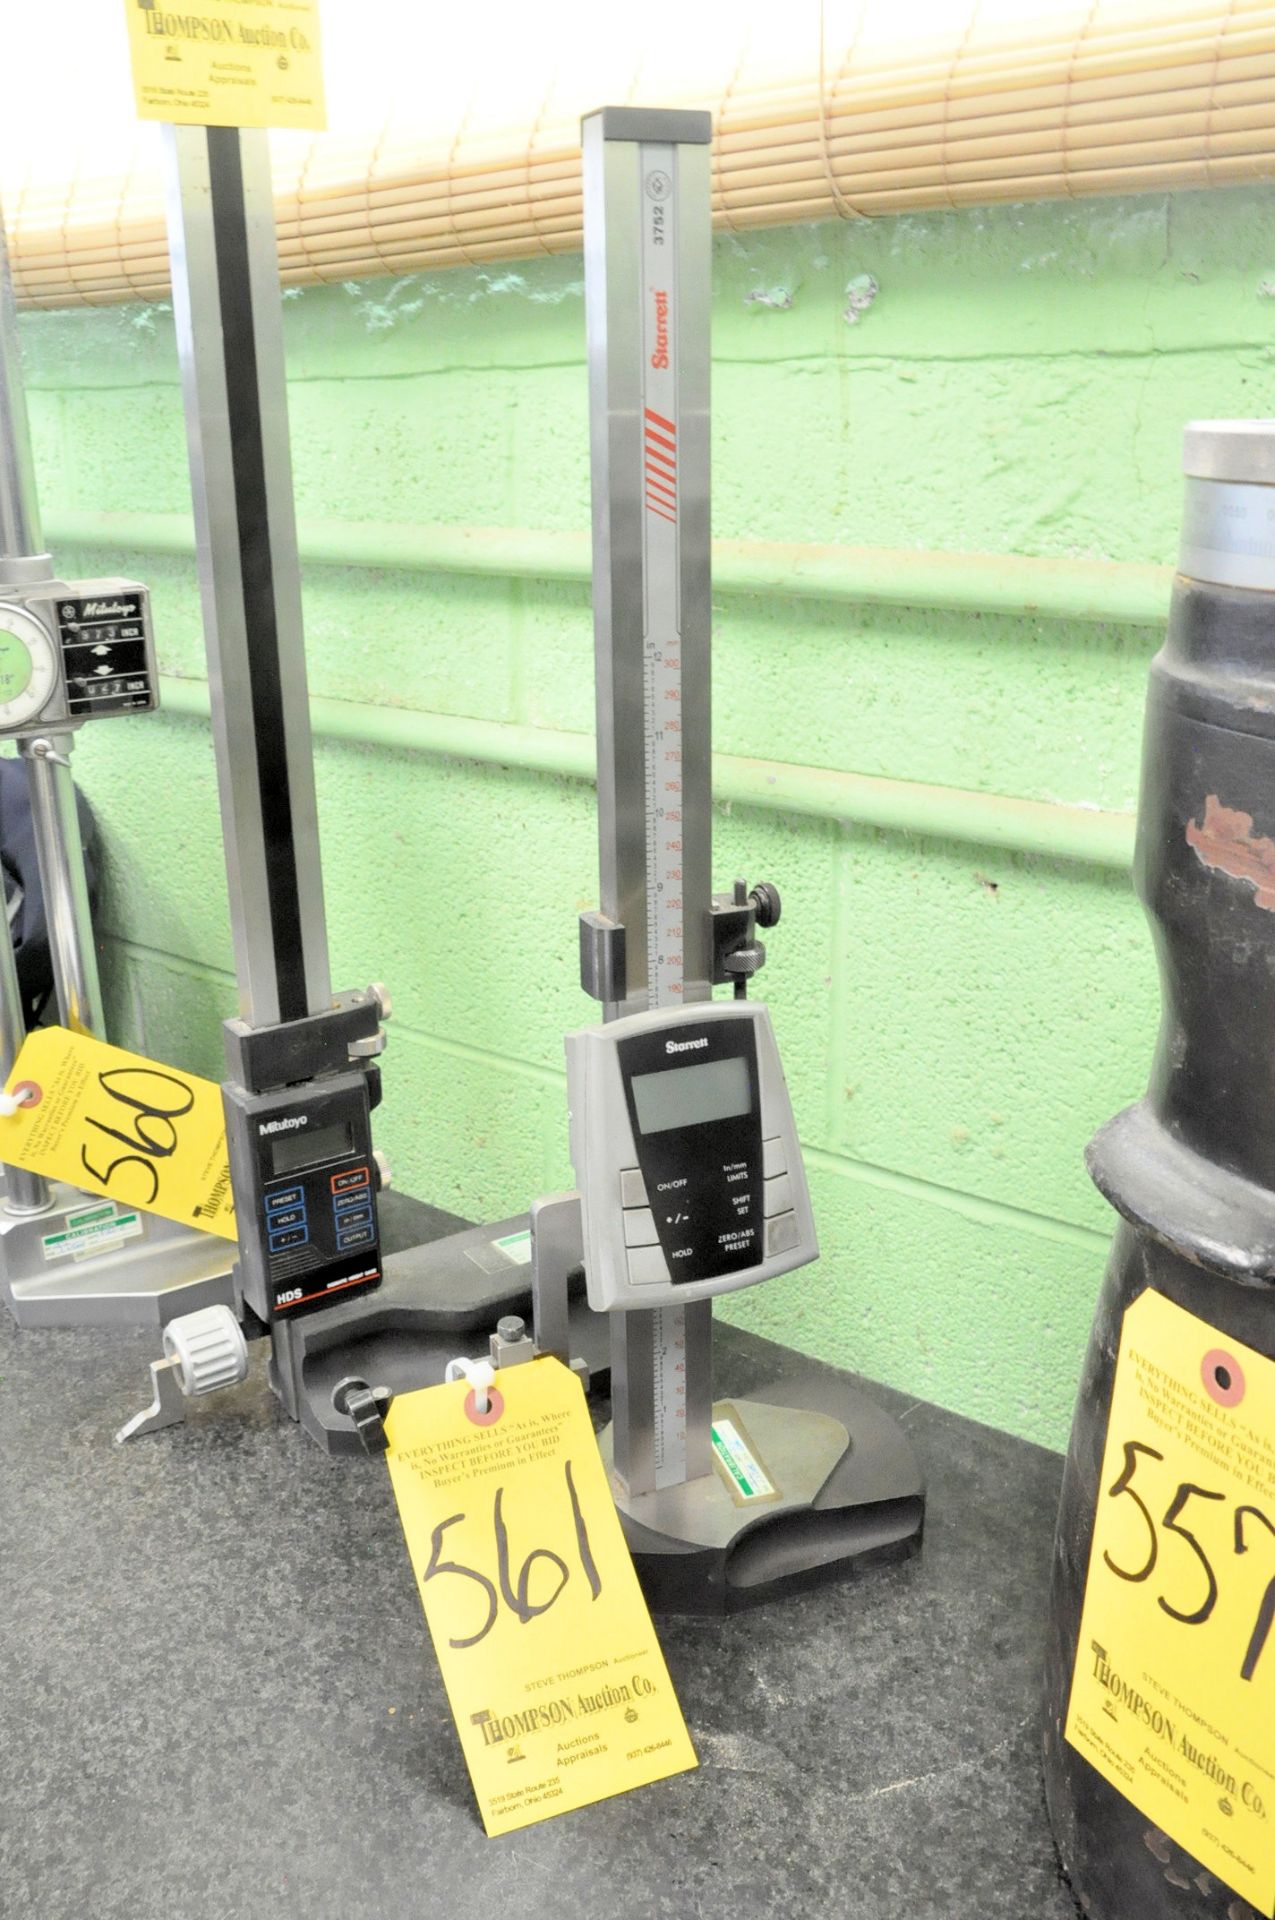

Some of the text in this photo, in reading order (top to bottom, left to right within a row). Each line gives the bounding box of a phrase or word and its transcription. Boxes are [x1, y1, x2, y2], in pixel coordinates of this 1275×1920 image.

[137, 0, 233, 42] THOMPSON
[239, 24, 287, 48] Auction
[212, 61, 251, 72] Auctions
[653, 206, 664, 245] 3752
[651, 291, 669, 370] Starrett
[83, 602, 136, 617] Mitutoyo
[665, 1037, 709, 1054] Starrett
[82, 1068, 194, 1204] 560
[259, 1115, 307, 1136] Mitutoyo
[657, 1179, 688, 1191] ON/OFF
[727, 1172, 748, 1183] LIMITS
[272, 1194, 297, 1206] PRESET
[732, 1195, 750, 1205] SHIFT
[737, 1206, 749, 1215] SET
[277, 1214, 296, 1224] HOLD
[344, 1231, 368, 1244] OUTPUT
[718, 1229, 755, 1243] ZERO/ABS
[725, 1240, 750, 1251] PRESET
[672, 1248, 693, 1259] HOLD
[277, 1288, 303, 1304] HDS
[1128, 1349, 1198, 1404] EVERYTHING
[1200, 1400, 1236, 1431] SELLS
[1147, 1376, 1159, 1393] No
[1163, 1386, 1214, 1431] Warranties
[1216, 1428, 1227, 1439] or
[398, 1435, 471, 1462] EVERYTHING
[474, 1426, 507, 1443] SELLS
[542, 1410, 572, 1425] Where
[1139, 1386, 1265, 1478] INSPECT BEFORE YOU
[420, 1434, 560, 1480] INSPECT BEFORE YOU BID
[424, 1455, 437, 1467] No
[439, 1441, 492, 1464] Warranties
[494, 1440, 504, 1449] or
[1185, 1433, 1229, 1472] Premium
[1233, 1466, 1243, 1479] in
[434, 1448, 556, 1488] Buyer's Premium in Effect
[423, 1460, 601, 1648] 561
[525, 1678, 555, 1693] STEVE
[557, 1659, 609, 1682] THOMPSON
[470, 1698, 574, 1746] THOMPSON
[578, 1684, 631, 1716] Auction
[1091, 1639, 1176, 1746] THOMPSON
[1178, 1733, 1236, 1795] Auction
[1141, 1672, 1170, 1700] STEVE
[1172, 1696, 1229, 1746] THOMPSON
[556, 1732, 600, 1752] Auctions
[556, 1744, 608, 1768] Appraisals
[1144, 1746, 1187, 1787] Auctions
[525, 1782, 545, 1796] Route
[1138, 1756, 1189, 1804] Appraisals
[524, 1796, 542, 1808] Ohio
